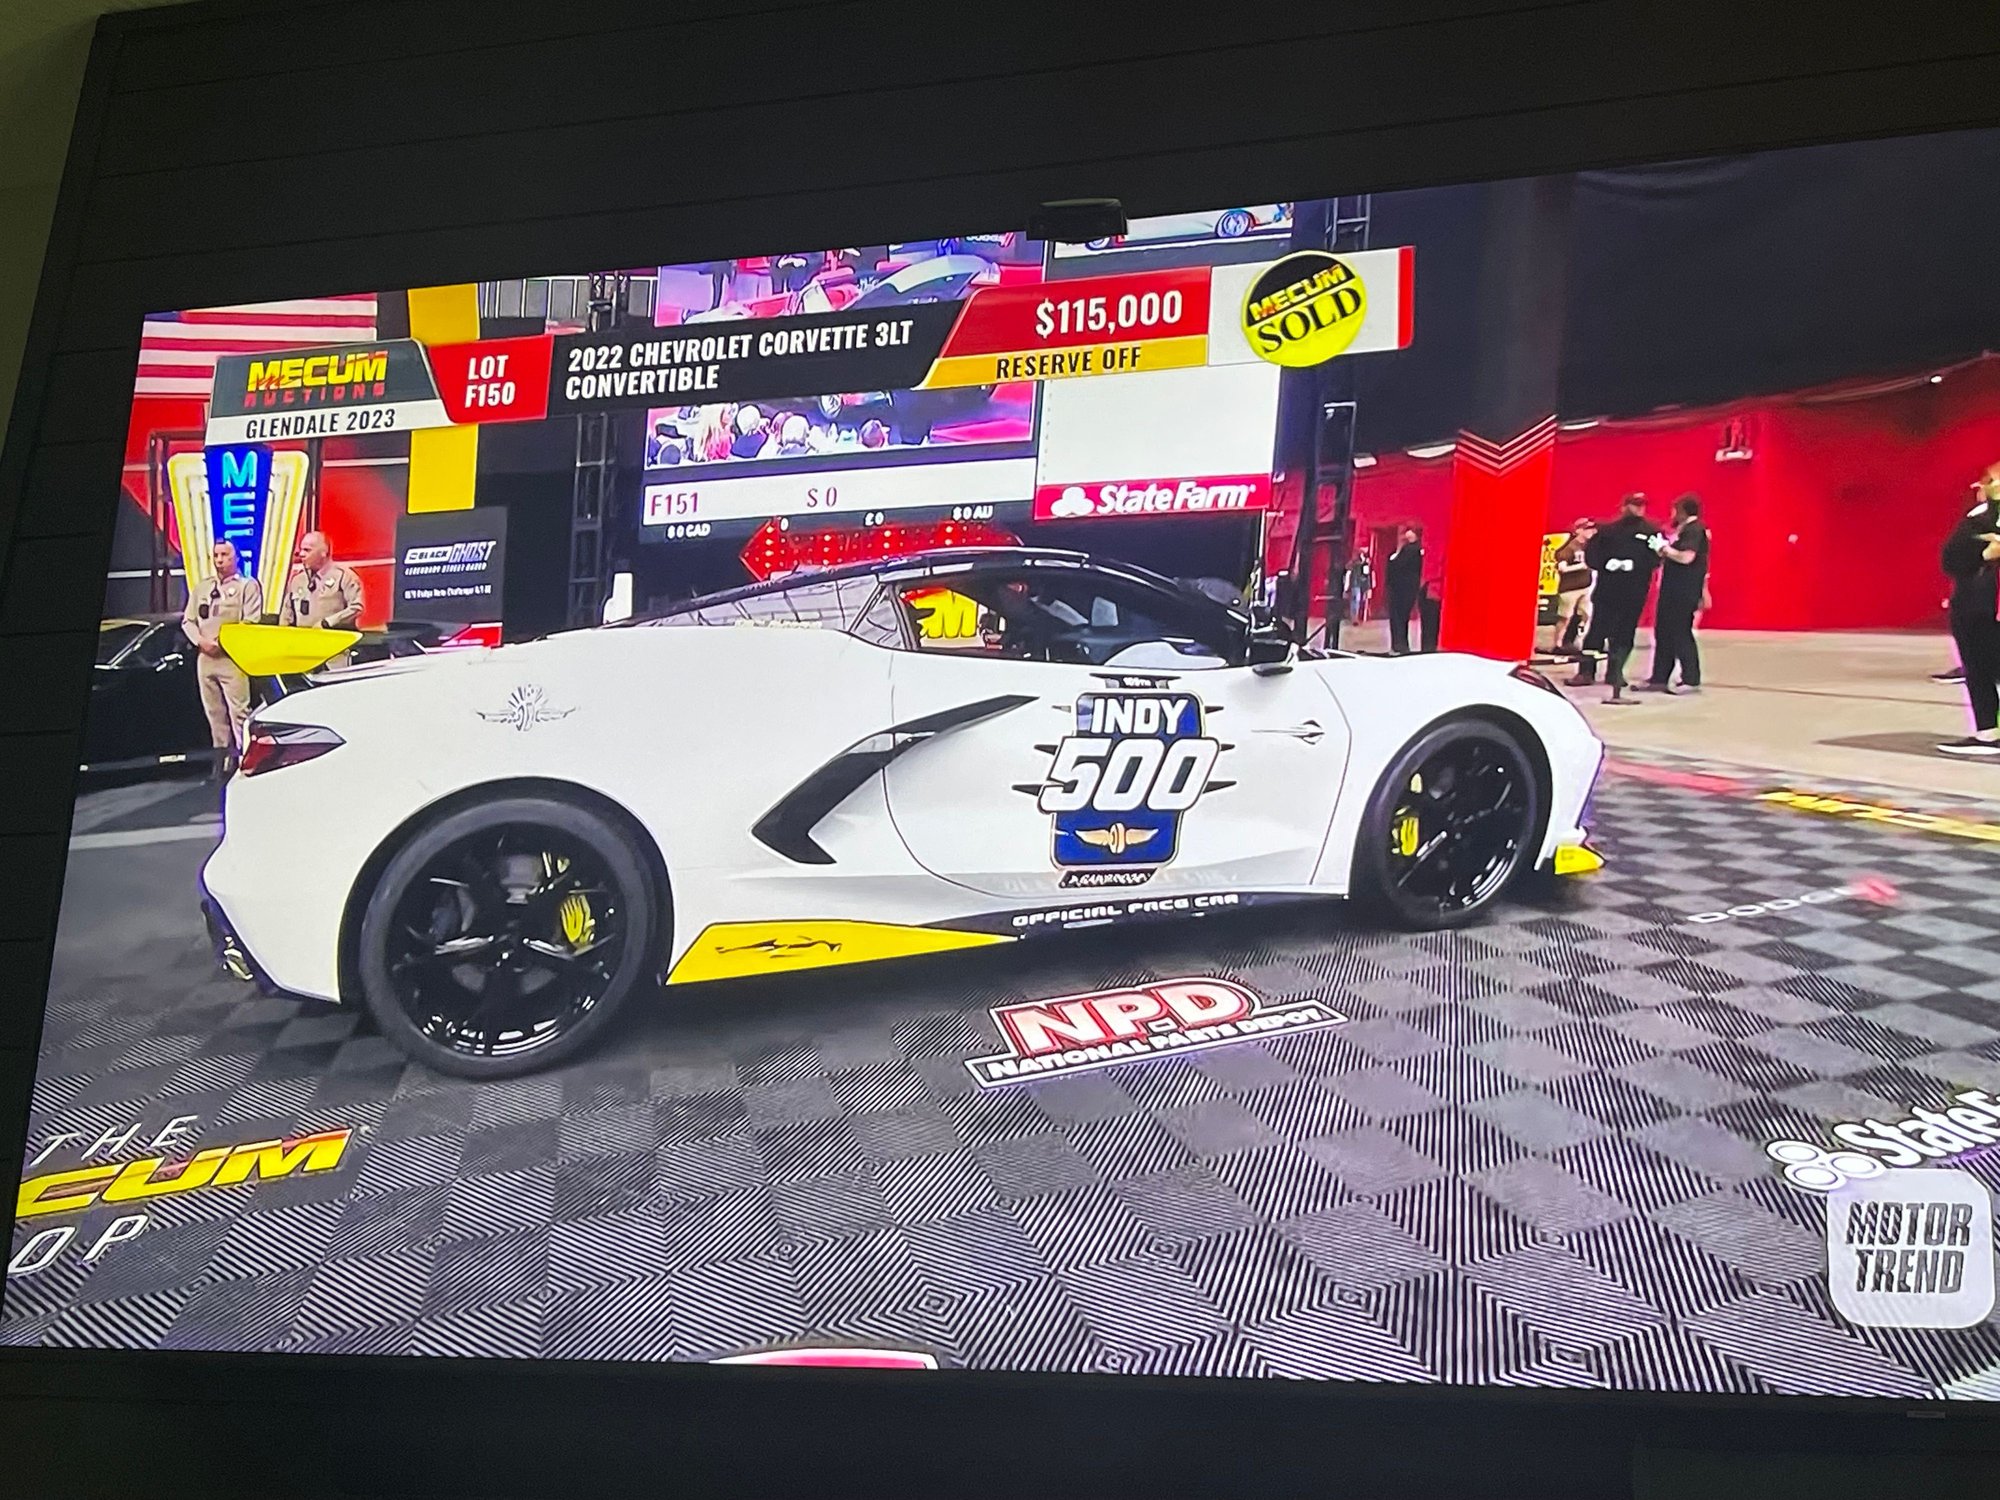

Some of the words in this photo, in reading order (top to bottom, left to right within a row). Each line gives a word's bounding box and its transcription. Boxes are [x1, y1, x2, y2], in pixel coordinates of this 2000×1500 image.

[1249, 263, 1350, 318] MECUM
[1034, 289, 1183, 338] $115,000
[1256, 288, 1362, 354] SOLD
[468, 354, 508, 379] LOT
[568, 344, 623, 373] 2022
[629, 334, 753, 366] CHEVROLET
[757, 324, 868, 356] CORVETTE
[874, 320, 914, 347] 3LT
[995, 355, 1093, 380] RESERVE
[1101, 346, 1142, 370] OFF
[247, 351, 388, 393] MECUM
[565, 364, 720, 400] CONVERTIBLE
[244, 382, 385, 408] AUCTIONS
[464, 381, 516, 409] F150
[245, 412, 340, 439] GLENDALE
[346, 408, 395, 431] 2023
[650, 491, 700, 517] F151
[449, 540, 497, 563] GHOST
[1090, 697, 1189, 735] INDY
[1039, 738, 1220, 812] 500
[1012, 905, 1122, 927] OFFICIAL
[1128, 898, 1189, 914] PACE
[1194, 894, 1239, 908] CAR
[1006, 982, 1247, 1055] NPD
[986, 1040, 1150, 1079] NATIONAL
[1145, 1021, 1236, 1050] PARTS
[1242, 1007, 1325, 1034] DEPOT
[30, 1115, 198, 1167] THE
[1845, 1201, 1974, 1247] MOTOR
[1855, 1249, 1965, 1294] TREND
